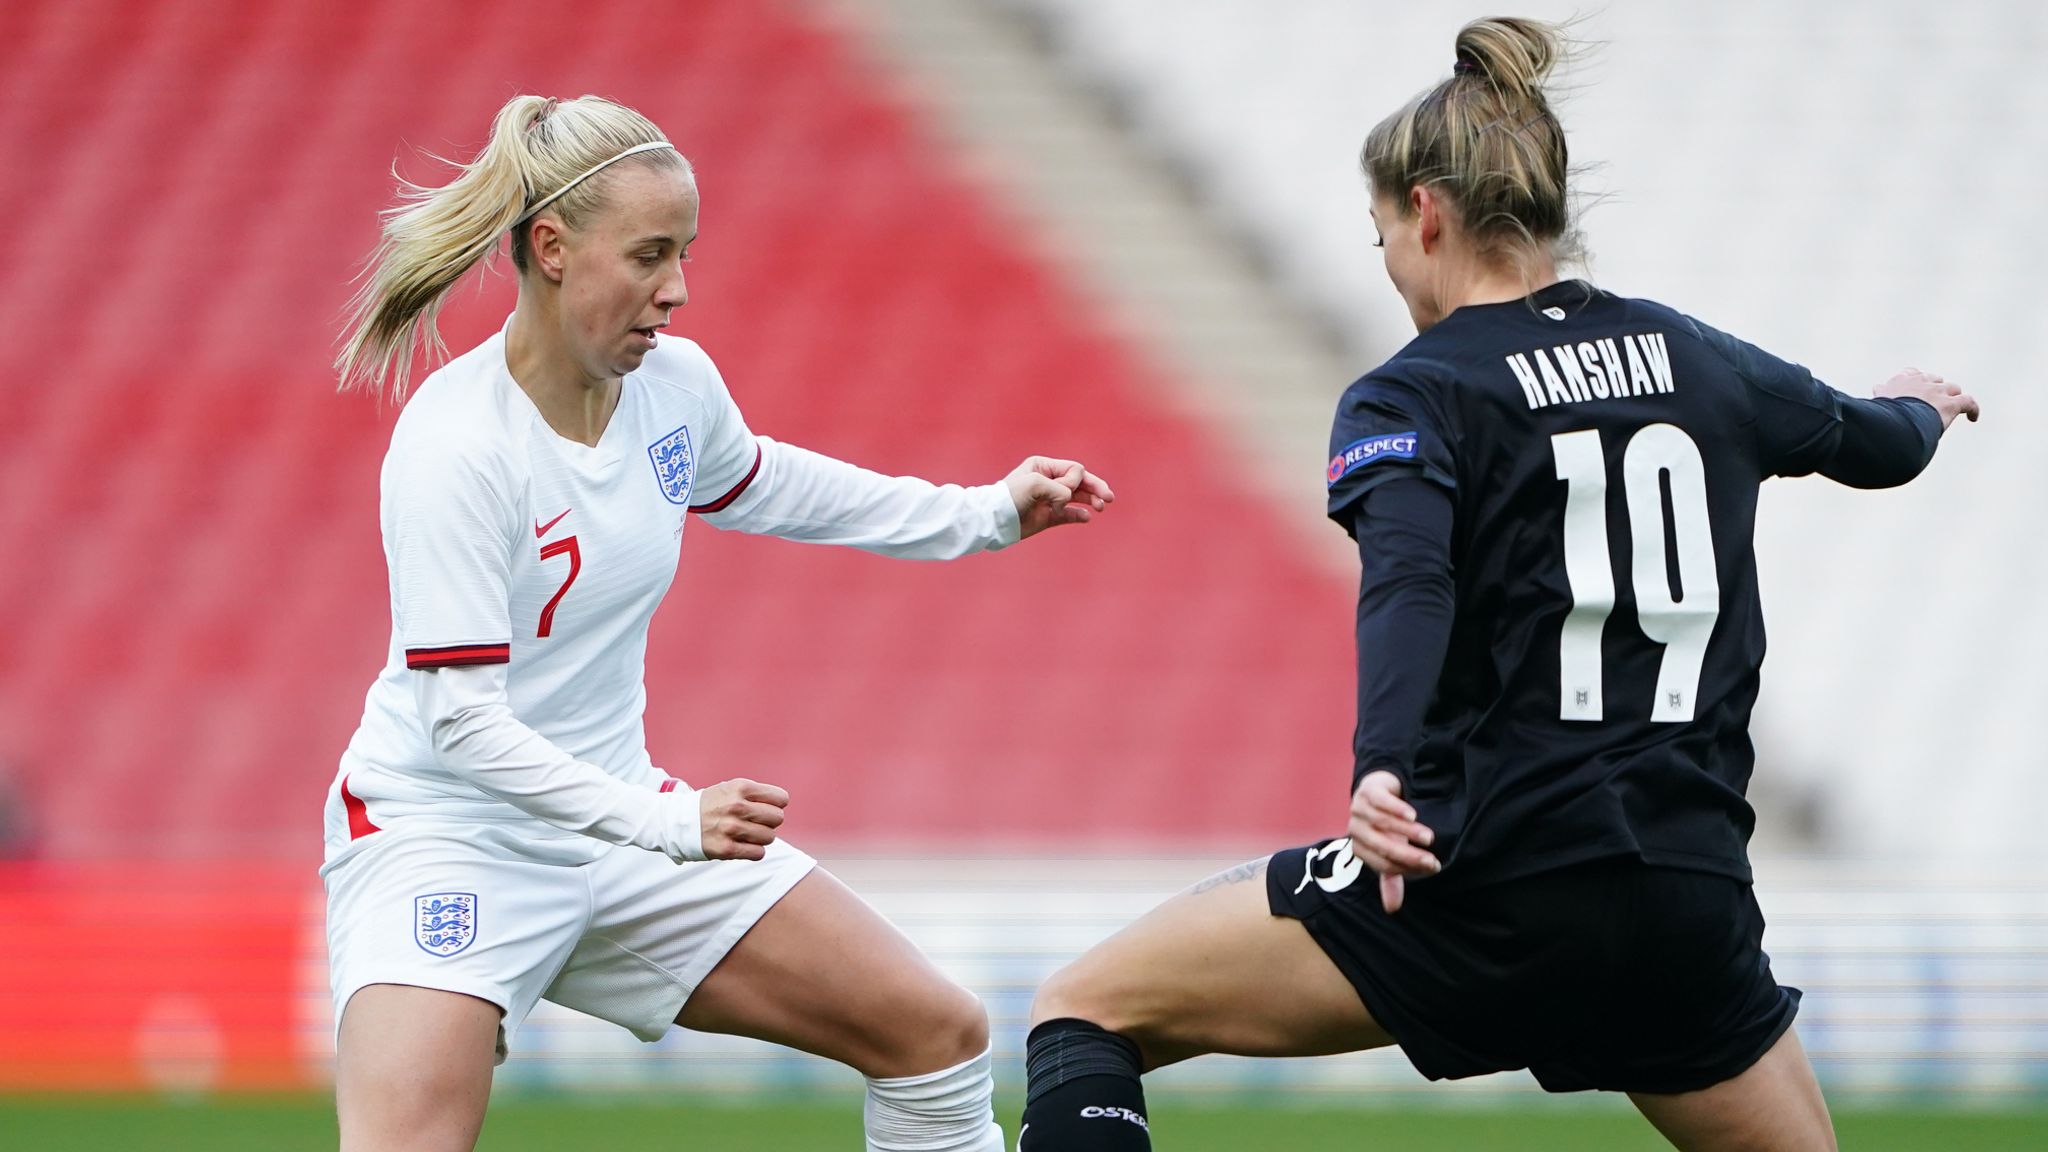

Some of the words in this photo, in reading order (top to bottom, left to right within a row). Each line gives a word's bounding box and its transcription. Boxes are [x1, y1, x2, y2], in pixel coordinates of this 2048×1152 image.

[1505, 332, 1675, 410] HANSHAW
[1345, 437, 1417, 467] RESPECT
[536, 534, 582, 638] 7
[1550, 422, 1720, 723] 19
